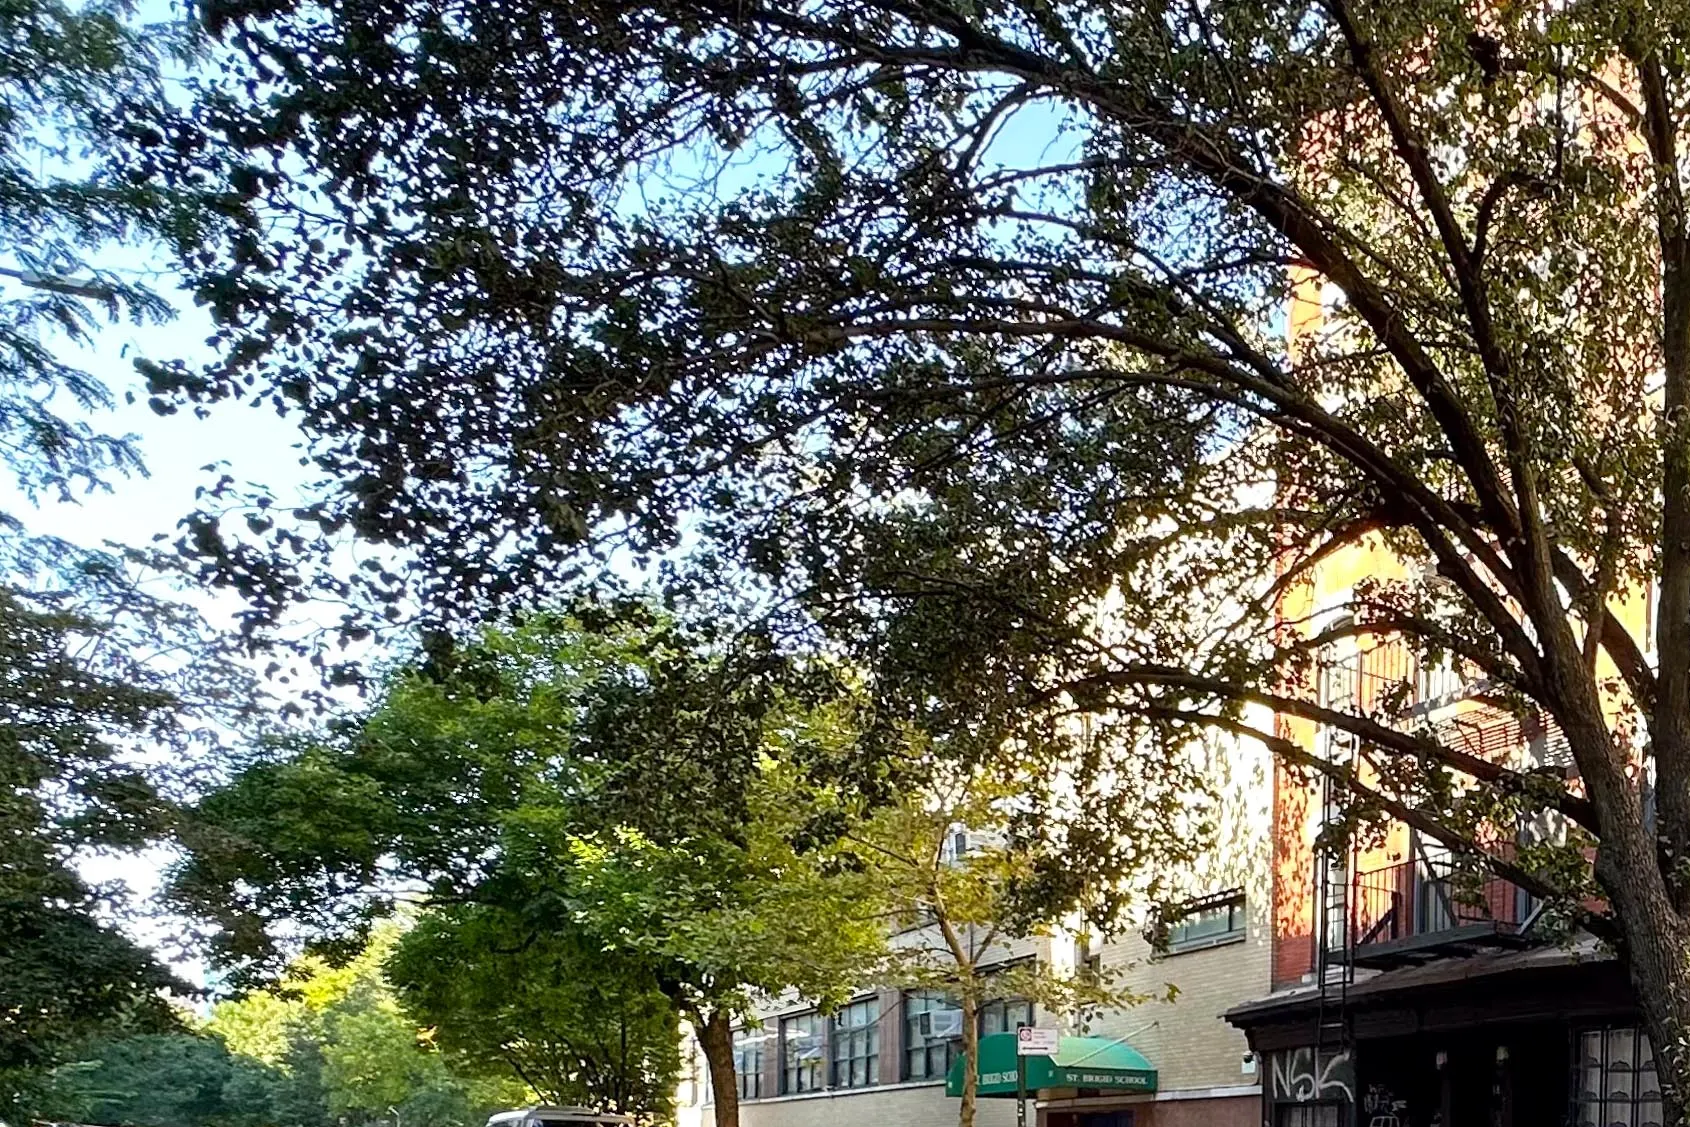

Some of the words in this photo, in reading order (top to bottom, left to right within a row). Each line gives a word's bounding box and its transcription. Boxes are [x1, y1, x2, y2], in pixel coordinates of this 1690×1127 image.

[1066, 1073, 1079, 1082] ST.
[1082, 1073, 1112, 1083] BRIGID
[1114, 1075, 1148, 1085] SCHOOL
